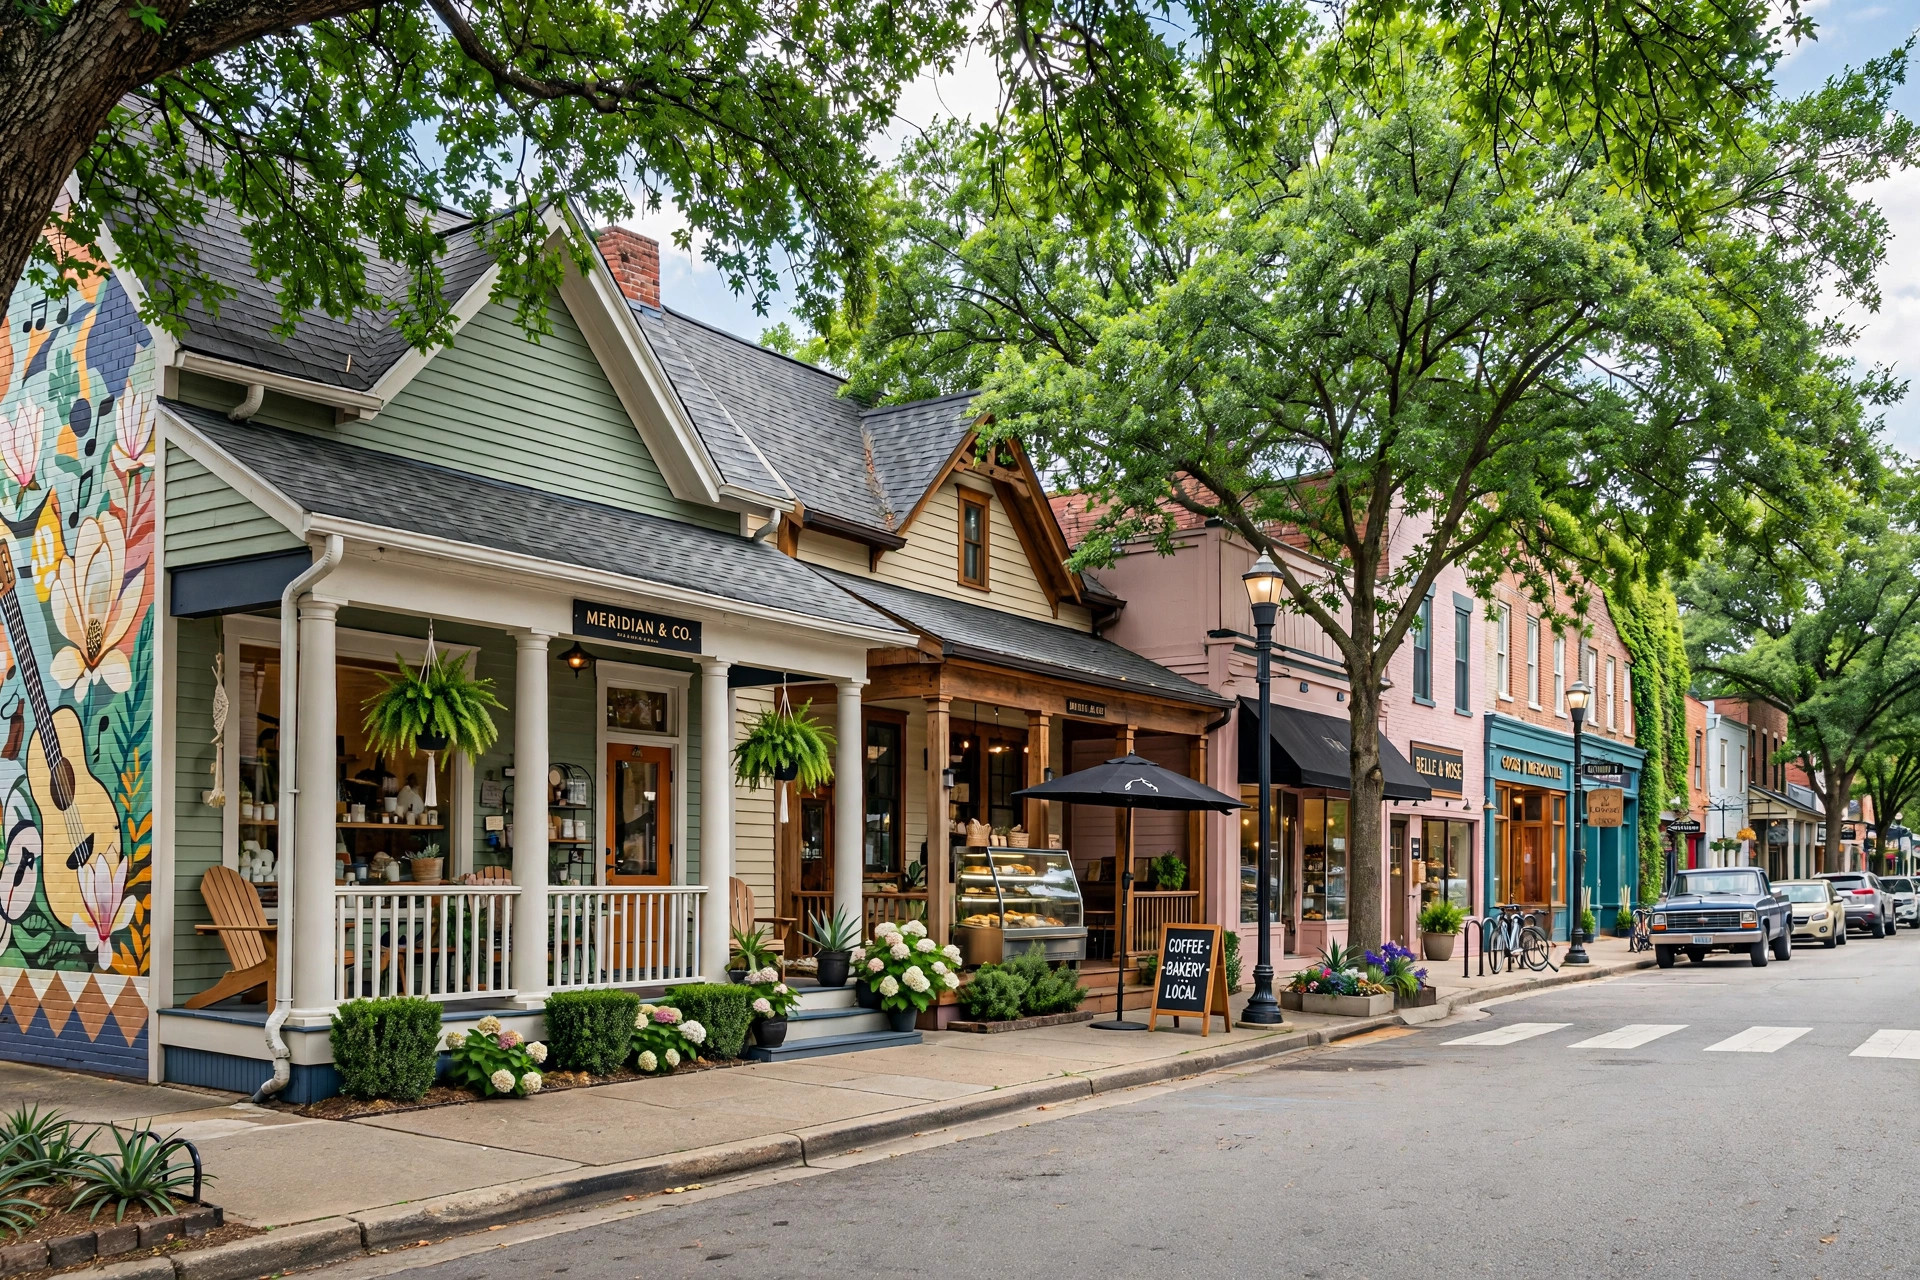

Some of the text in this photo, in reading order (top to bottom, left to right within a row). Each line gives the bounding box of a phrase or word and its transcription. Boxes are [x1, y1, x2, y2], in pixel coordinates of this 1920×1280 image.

[586, 610, 654, 635] MERIDIAN
[658, 622, 667, 638] &
[671, 625, 692, 641] CO.
[1415, 756, 1437, 776] BELLE
[1168, 938, 1205, 955] COFFEE
[1165, 961, 1206, 978] BAKERY
[1165, 984, 1198, 1000] LOCAL
